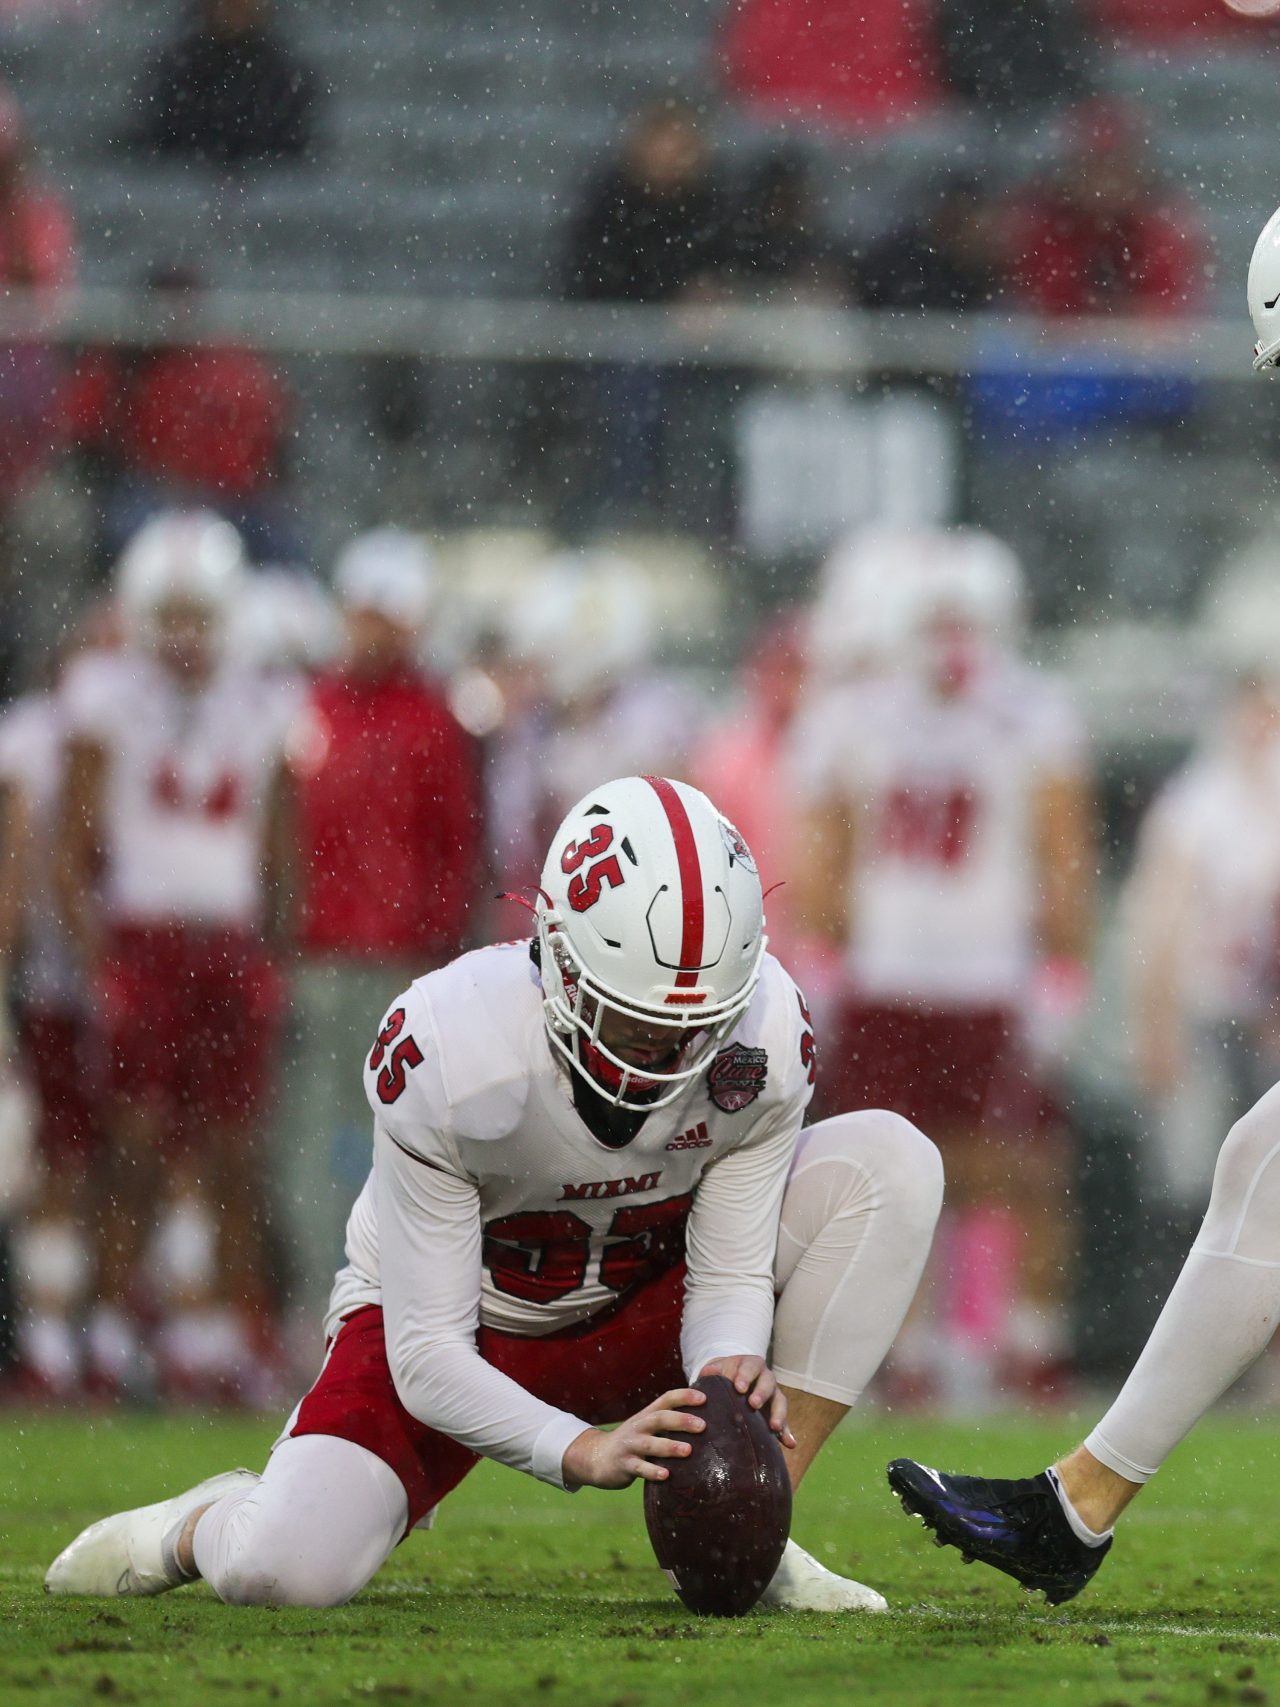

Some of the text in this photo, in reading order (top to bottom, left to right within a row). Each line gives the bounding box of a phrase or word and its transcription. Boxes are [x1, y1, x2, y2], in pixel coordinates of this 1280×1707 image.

[561, 824, 625, 913] 35
[369, 1008, 425, 1104] 35
[665, 1139, 713, 1151] adidas
